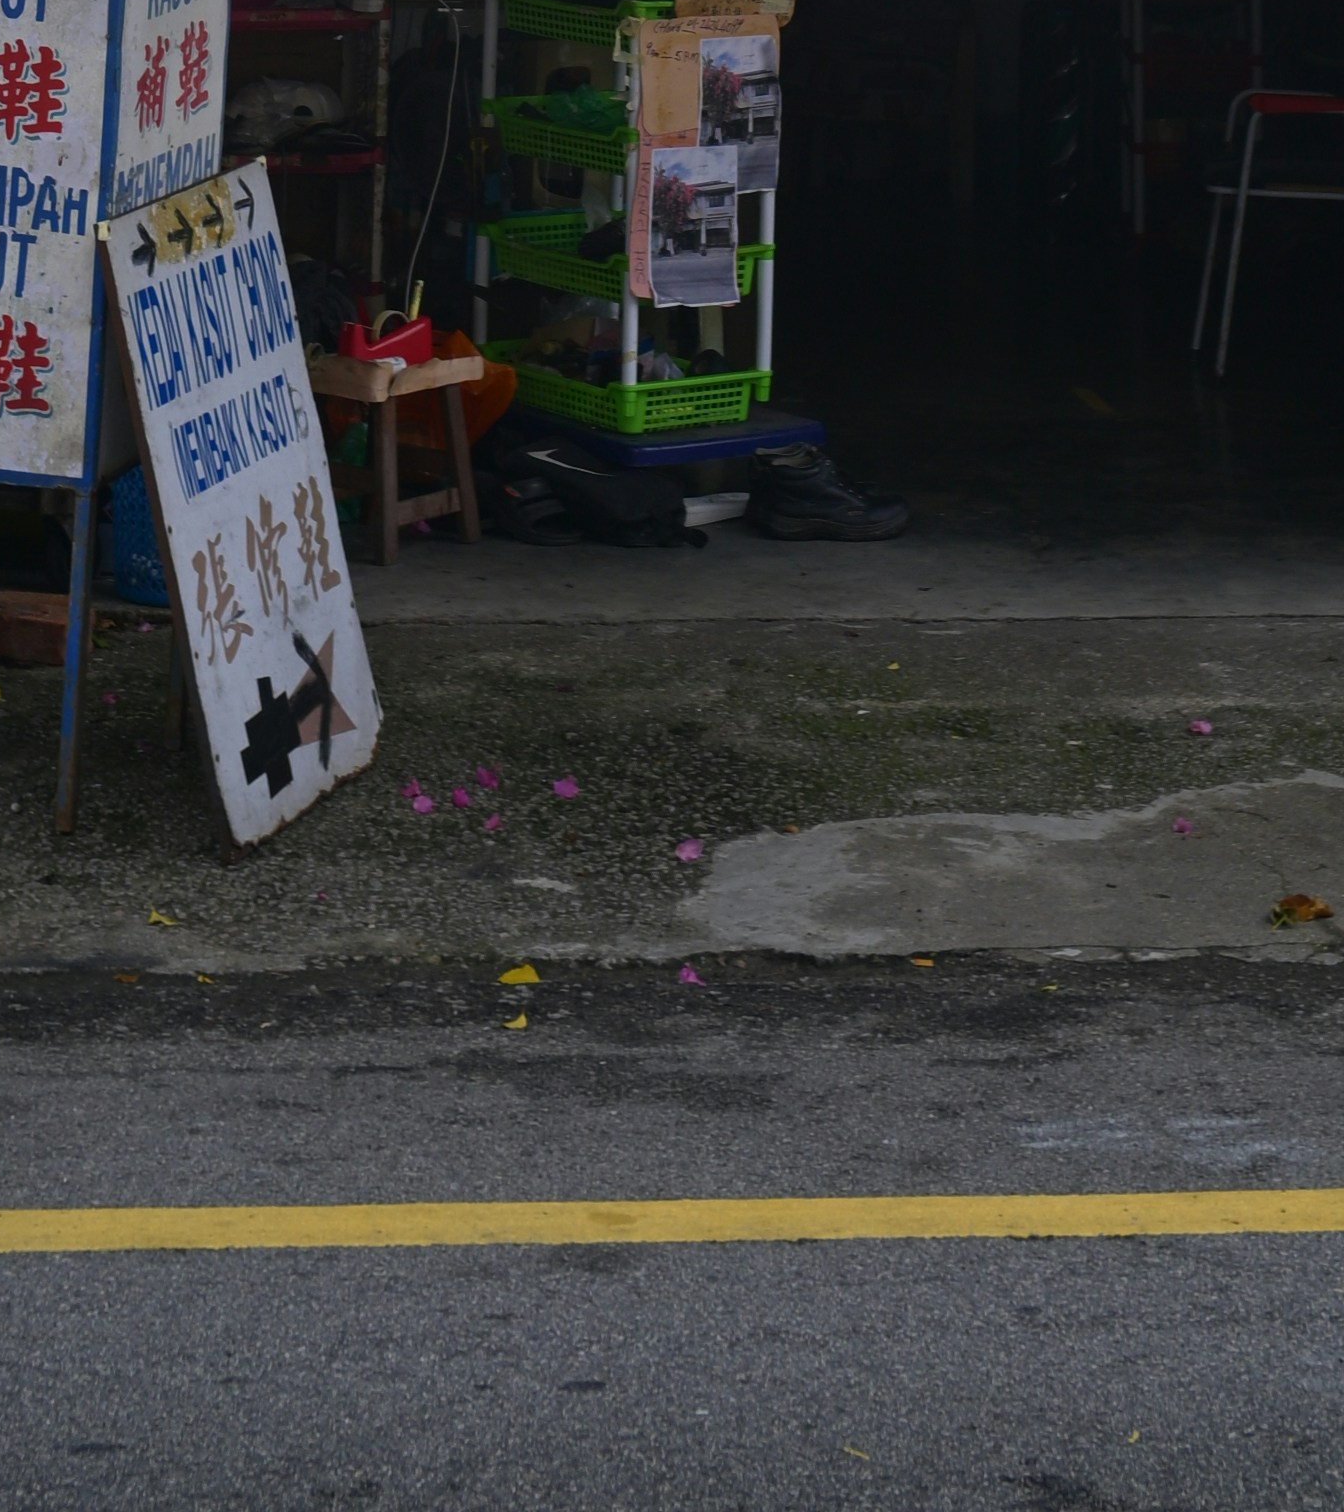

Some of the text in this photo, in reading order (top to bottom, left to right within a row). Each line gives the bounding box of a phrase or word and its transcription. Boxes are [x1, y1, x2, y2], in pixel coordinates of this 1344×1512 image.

[135, 19, 211, 132] 補鞋
[127, 230, 296, 411] KEDAI KASUT CHONG
